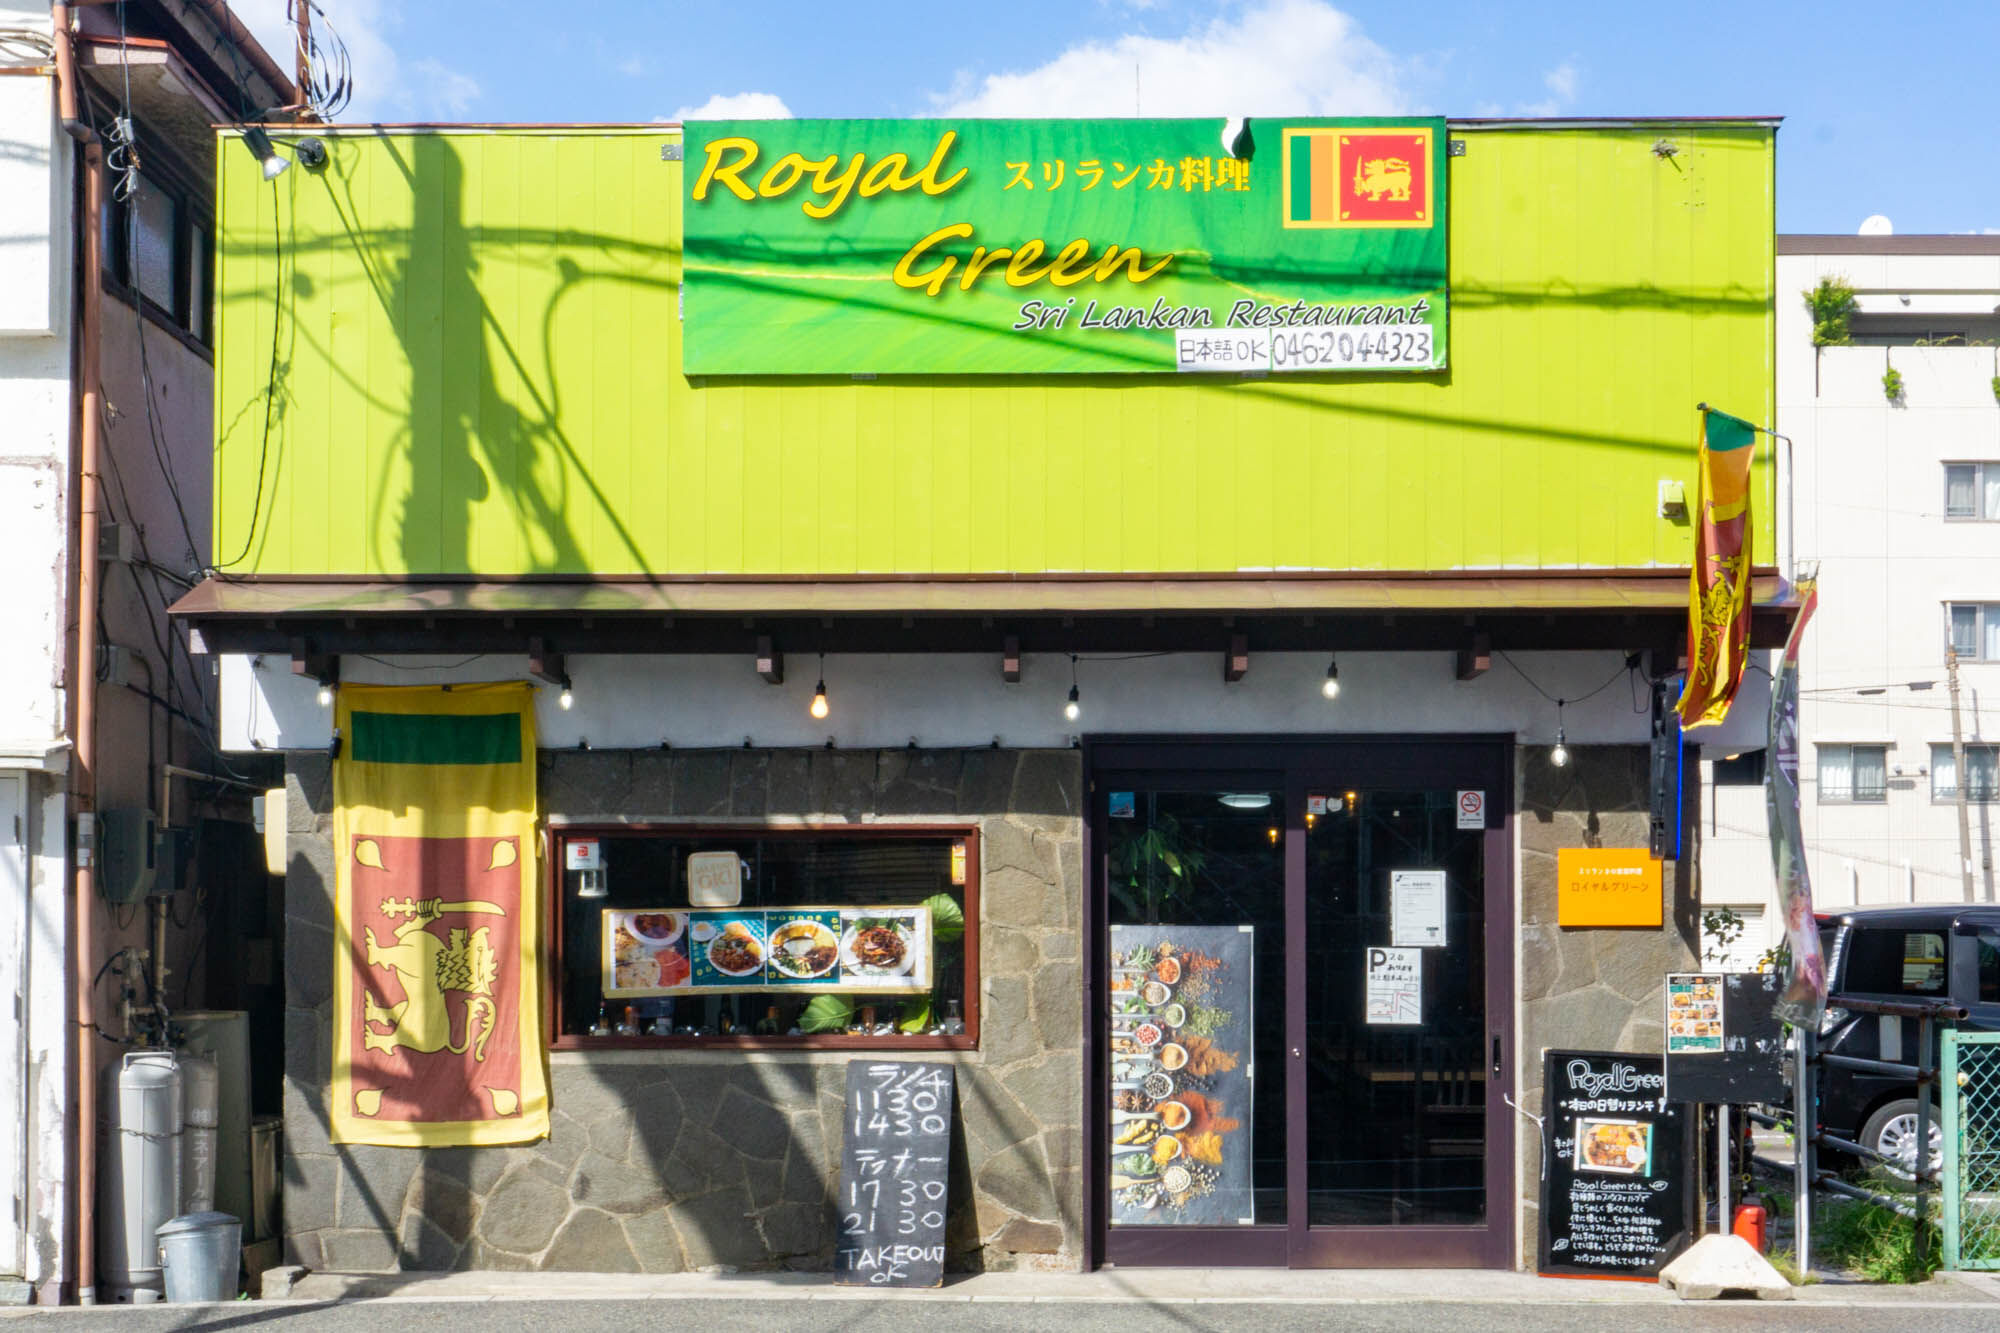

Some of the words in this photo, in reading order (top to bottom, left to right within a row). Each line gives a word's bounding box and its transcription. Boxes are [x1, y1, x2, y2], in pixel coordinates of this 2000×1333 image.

[692, 130, 969, 220] Royal
[1002, 156, 1251, 193] スリランカ料理
[892, 223, 1175, 297] Green
[1014, 297, 1075, 330] Sri
[1079, 296, 1213, 330] Lankan
[1226, 298, 1431, 328] Restaurant
[1370, 949, 1387, 973] P
[840, 1245, 945, 1270] TAKEOUT
